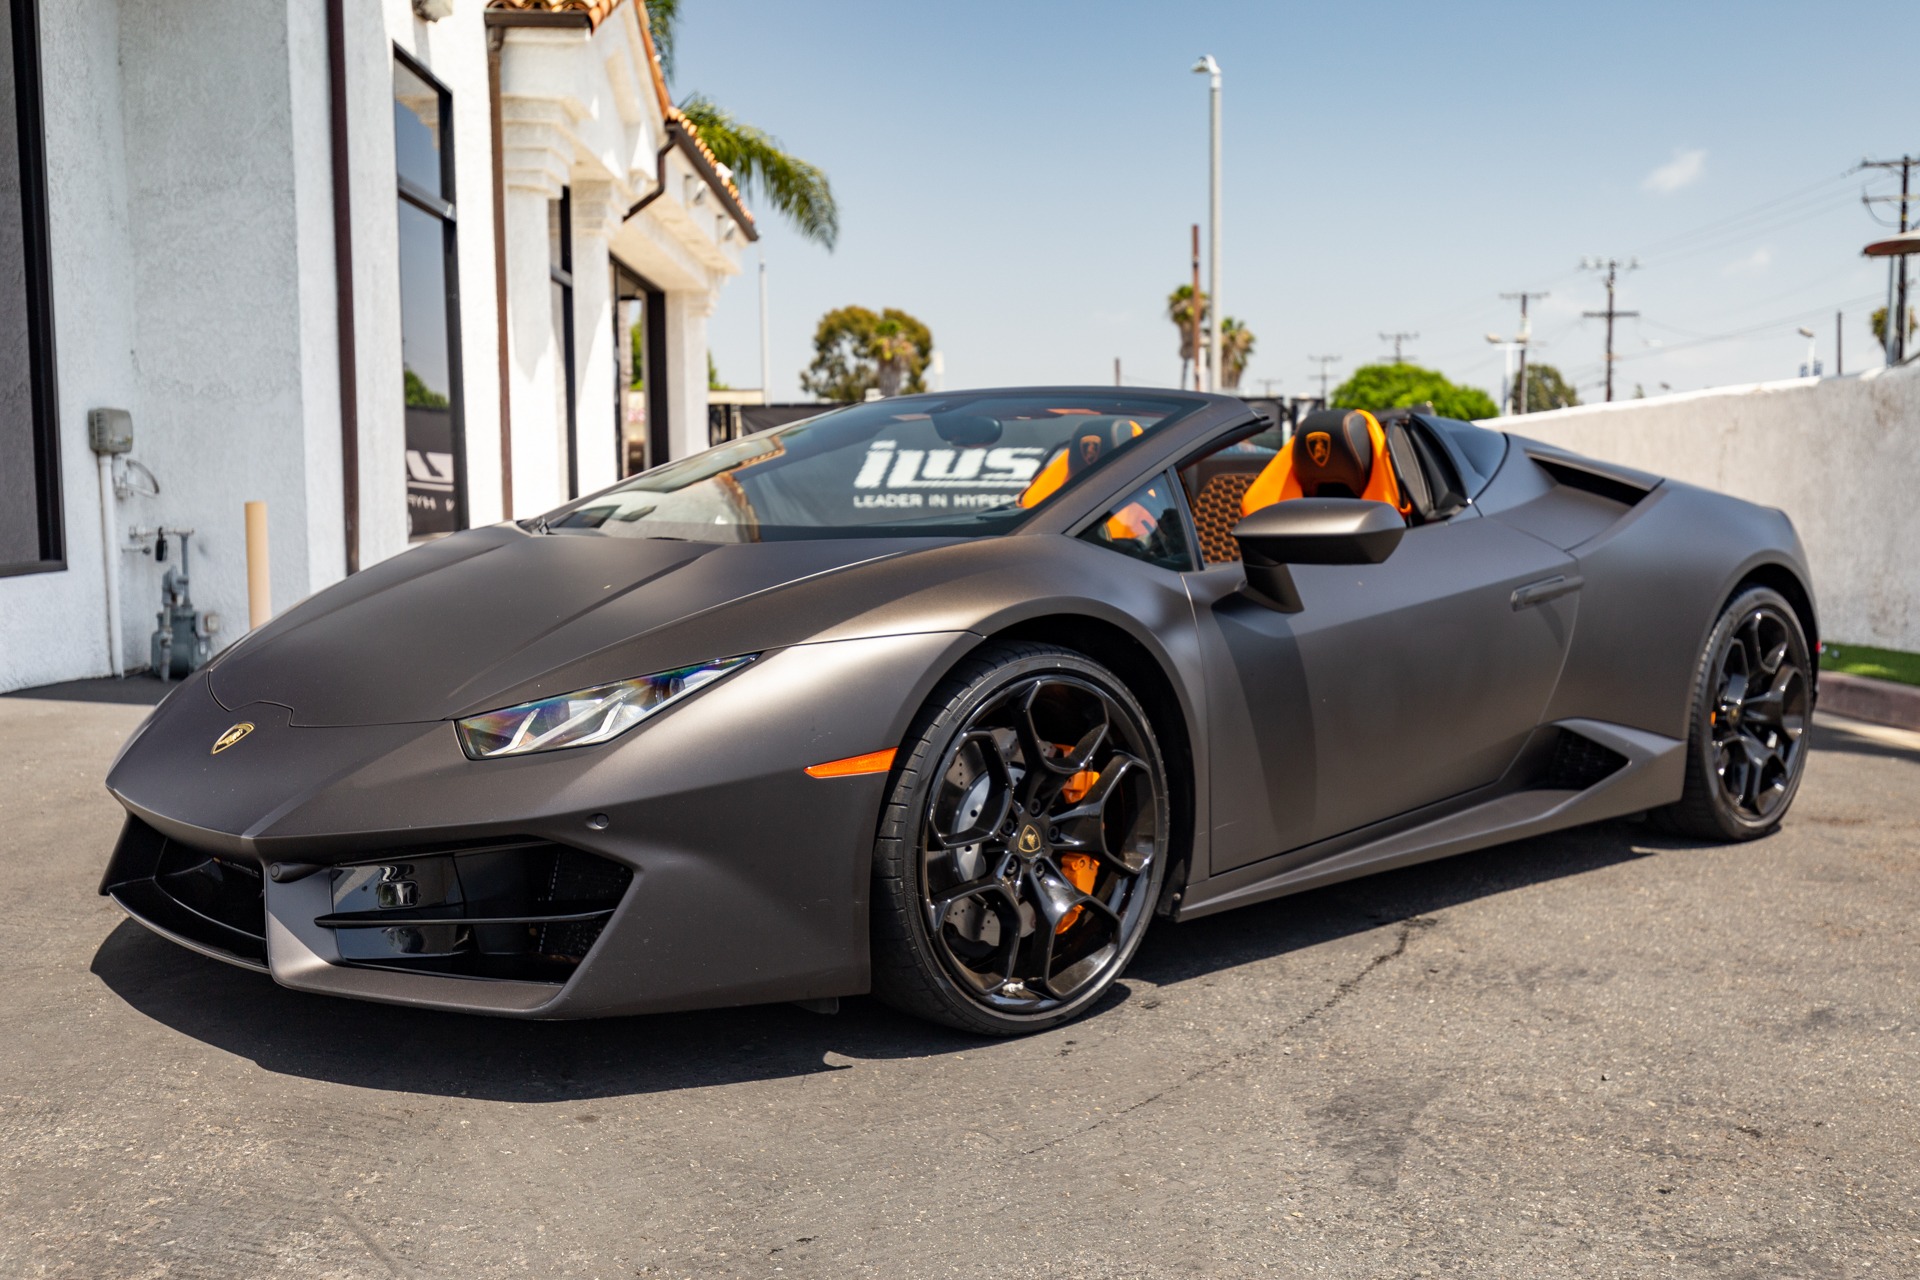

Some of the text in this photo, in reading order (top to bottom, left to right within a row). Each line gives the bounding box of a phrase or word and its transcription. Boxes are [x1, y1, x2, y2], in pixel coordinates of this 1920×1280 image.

[853, 440, 1046, 489] iLUS
[853, 493, 923, 509] LEADER
[928, 493, 948, 509] IN
